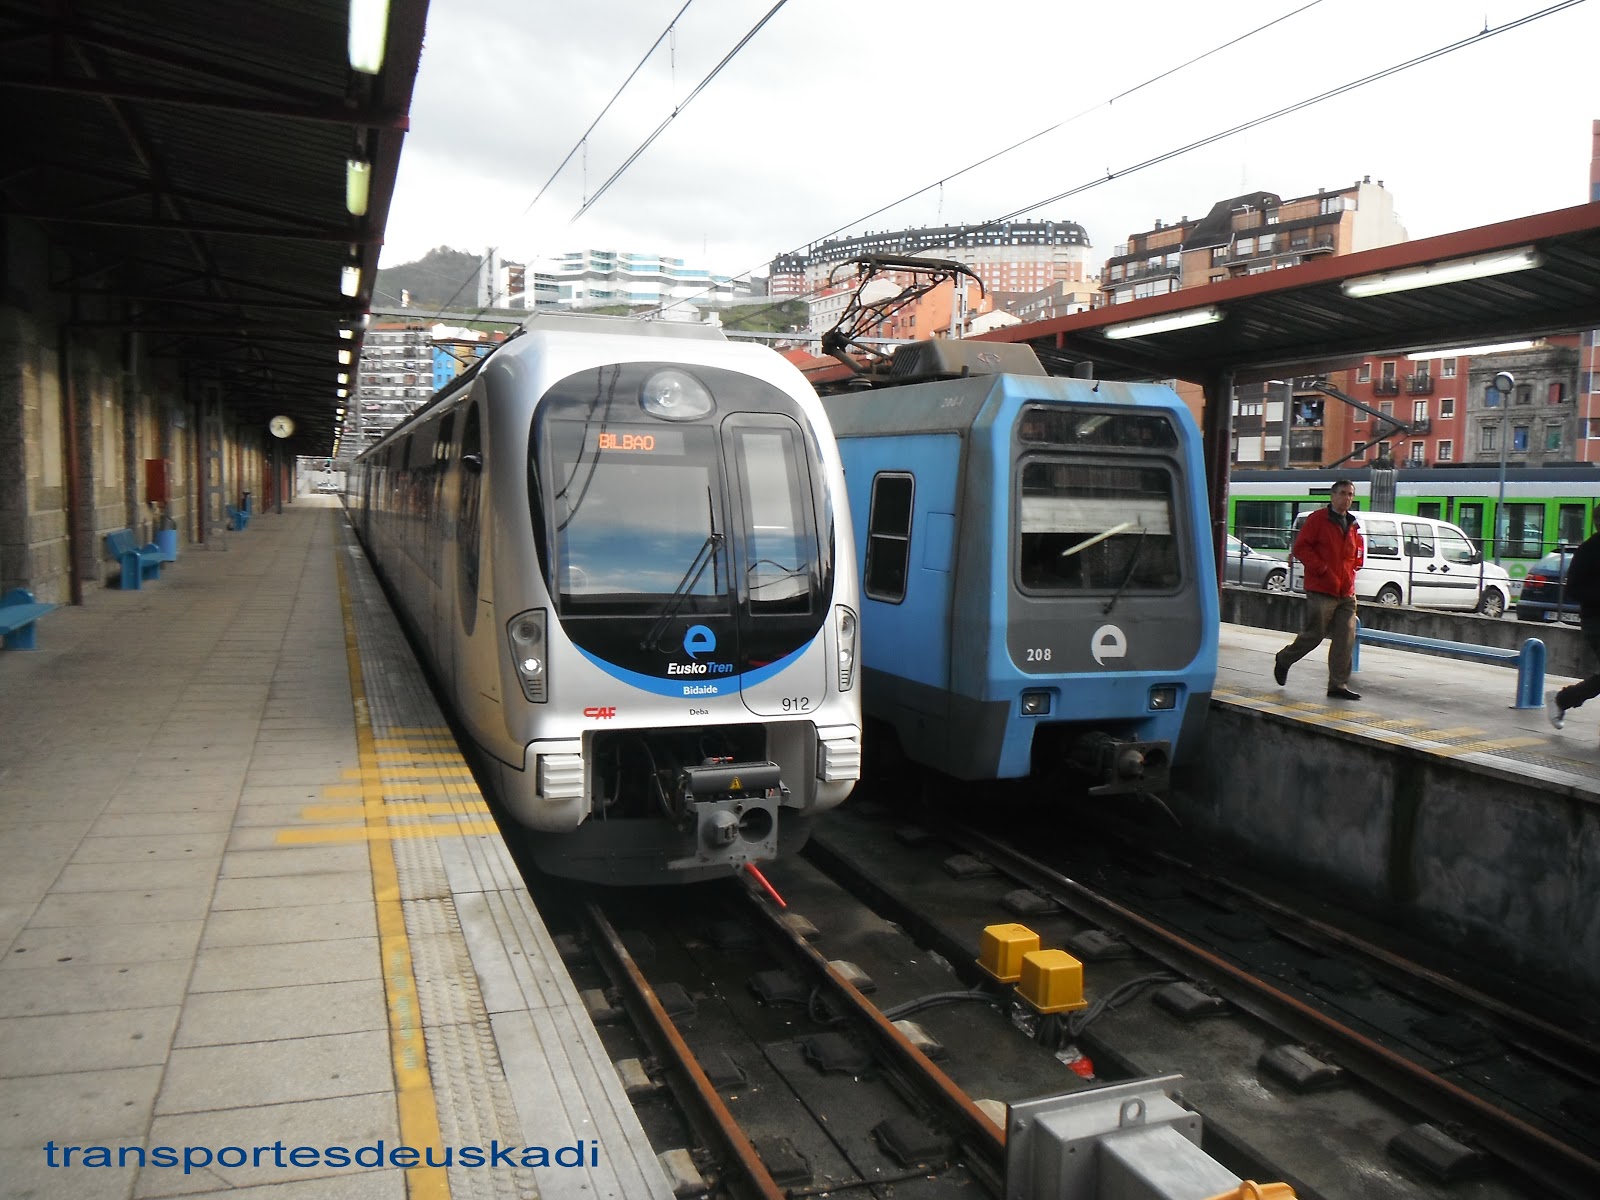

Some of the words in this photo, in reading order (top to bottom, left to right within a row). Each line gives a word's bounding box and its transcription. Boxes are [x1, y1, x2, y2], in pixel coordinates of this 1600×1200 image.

[599, 433, 655, 451] BILBAO
[1026, 648, 1052, 662] 208
[667, 661, 734, 675] EuskoTren
[683, 685, 718, 695] Bidaide
[782, 696, 810, 711] 912
[583, 706, 617, 720] CAF
[689, 708, 709, 716] Deba
